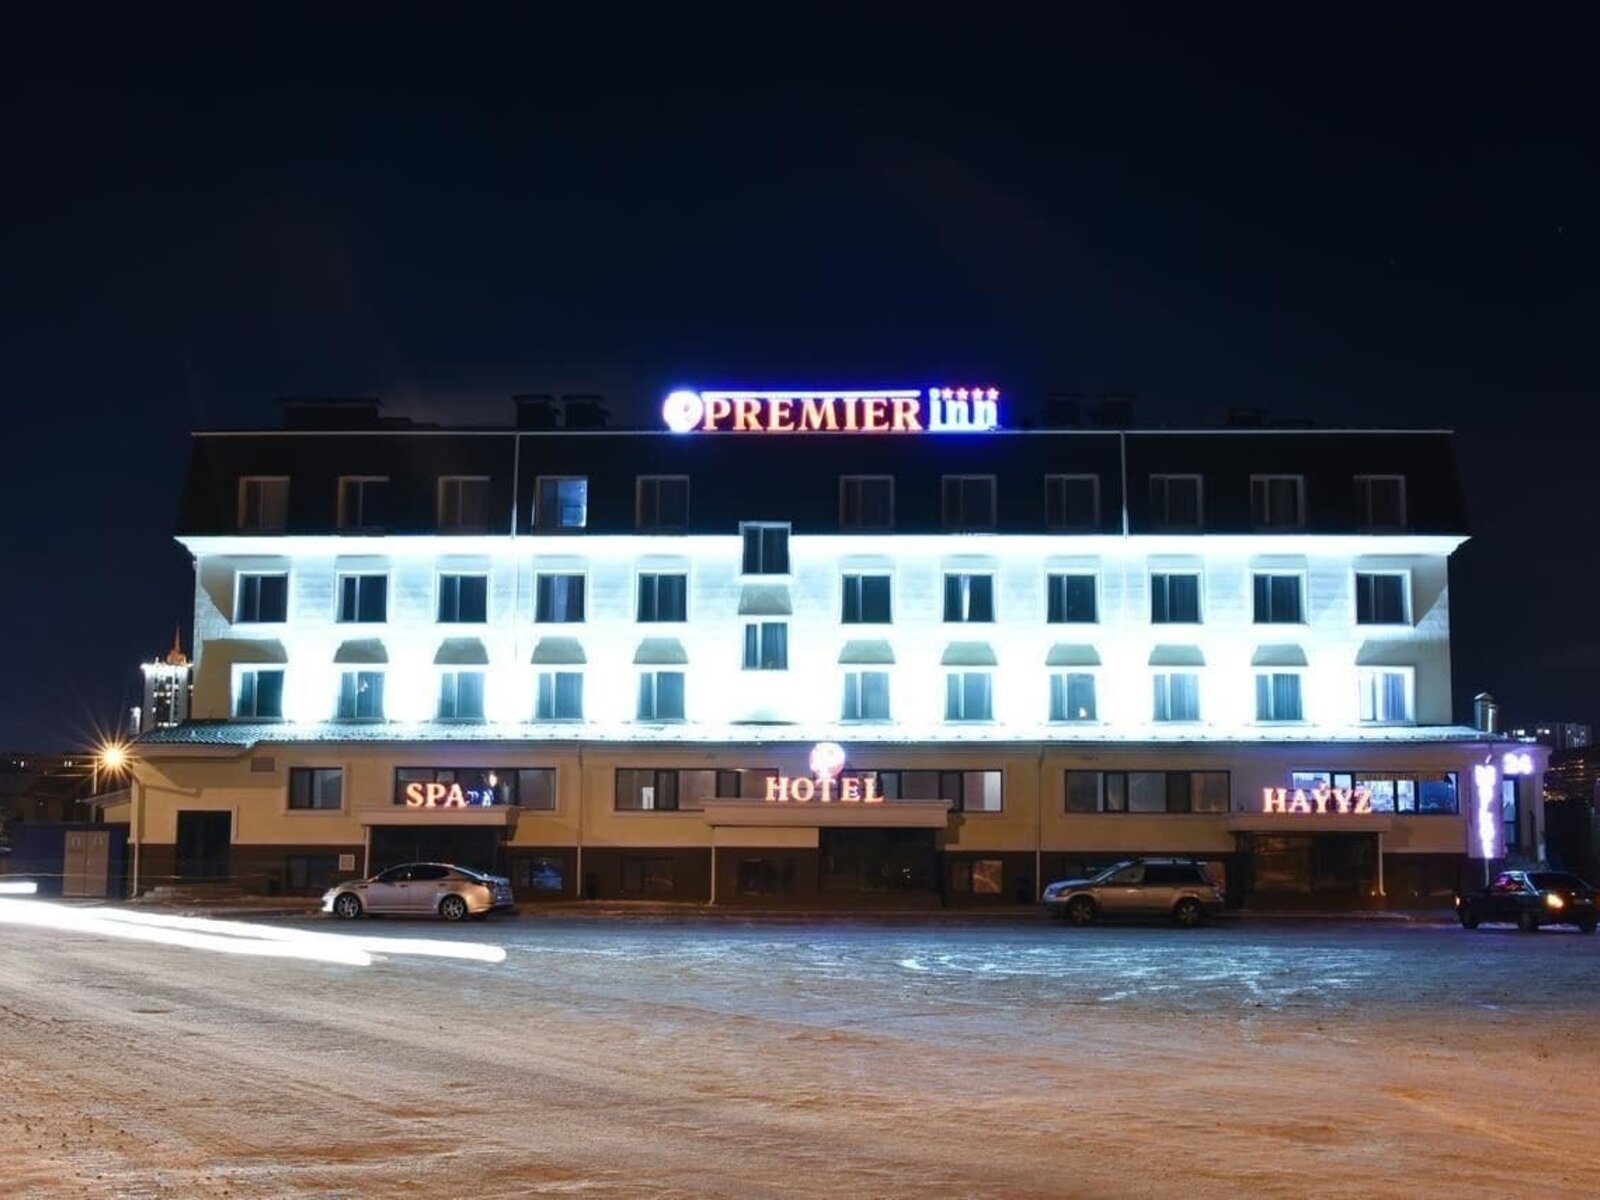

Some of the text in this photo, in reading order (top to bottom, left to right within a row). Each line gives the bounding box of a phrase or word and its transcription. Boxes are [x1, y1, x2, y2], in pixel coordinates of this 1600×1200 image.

[702, 397, 922, 431] PREMIER
[406, 783, 467, 808] SPA
[765, 776, 884, 802] HOTEL
